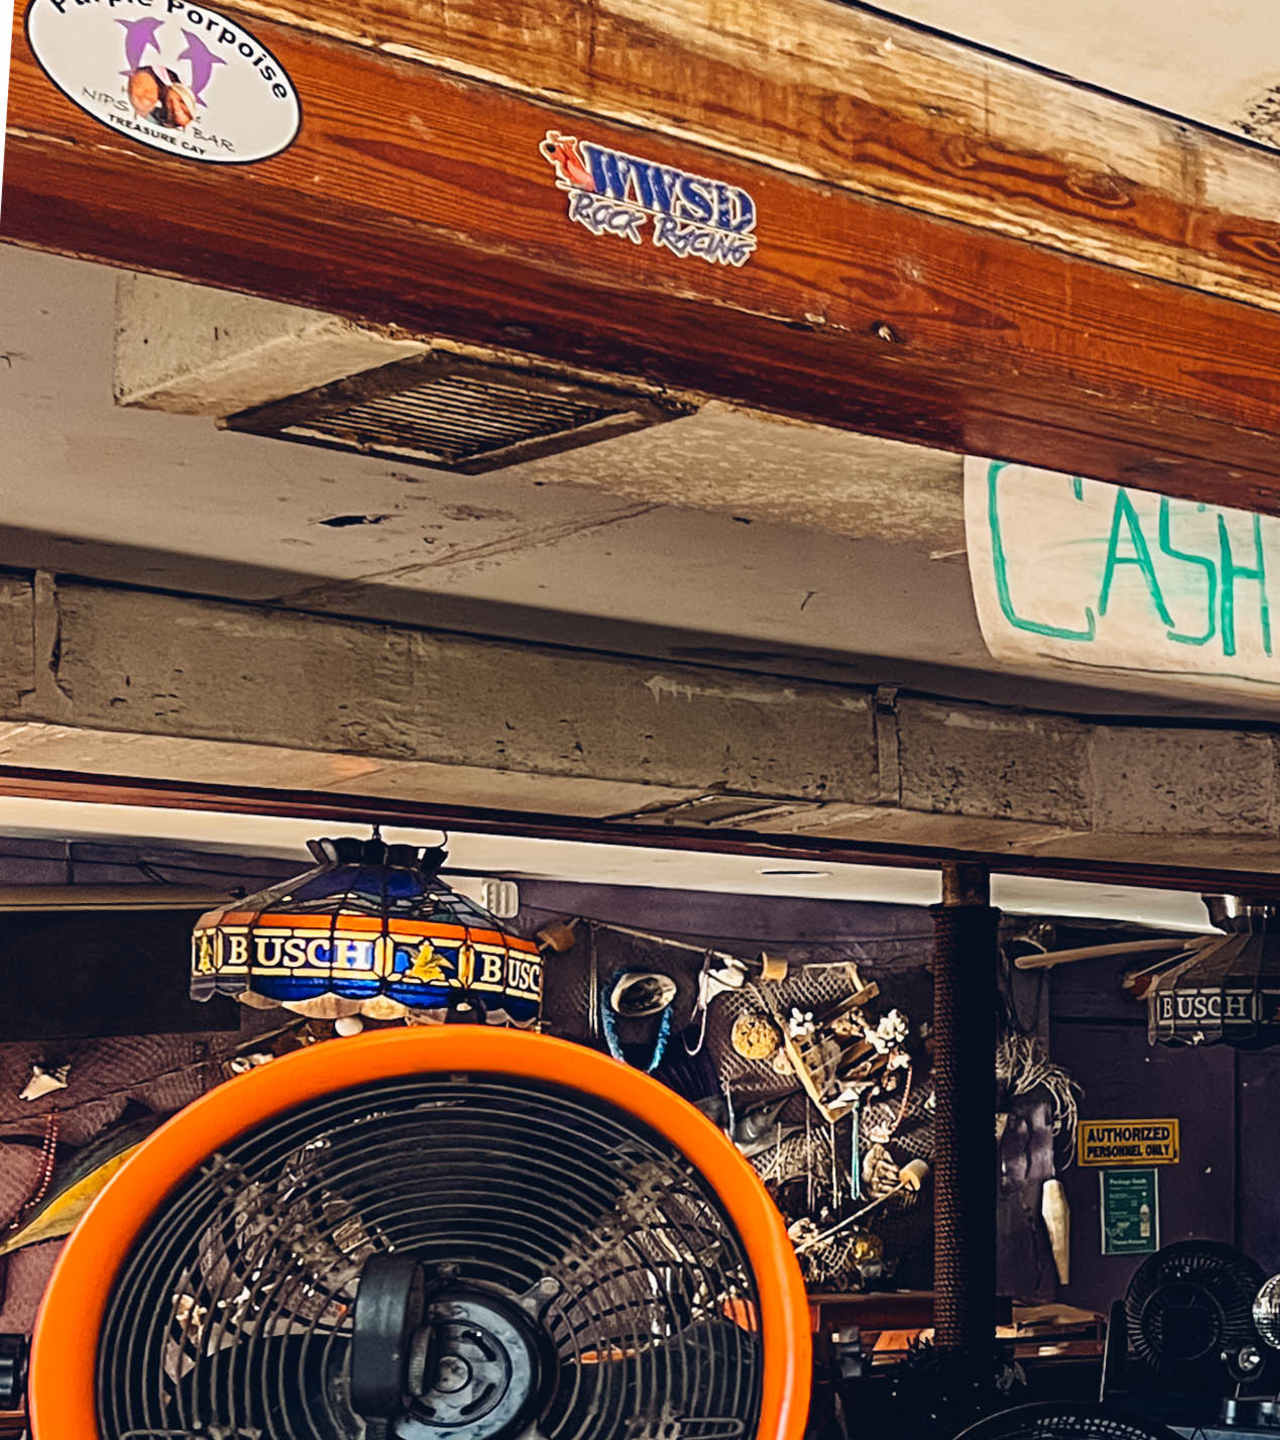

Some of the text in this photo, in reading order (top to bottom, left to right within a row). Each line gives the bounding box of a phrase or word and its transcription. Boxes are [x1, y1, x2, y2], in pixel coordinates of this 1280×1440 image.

[166, 0, 289, 100] Porpoise
[108, 113, 206, 156] TREASURE CAY
[579, 143, 755, 234] WWSD
[572, 192, 755, 264] ROCK RACING
[987, 460, 1273, 658] CASH
[228, 936, 374, 971] BUSCH
[1163, 996, 1246, 1018] BUSCH
[1087, 1127, 1170, 1142] AUTHORIZED
[1087, 1143, 1170, 1158] PERSONNEL ONLY
